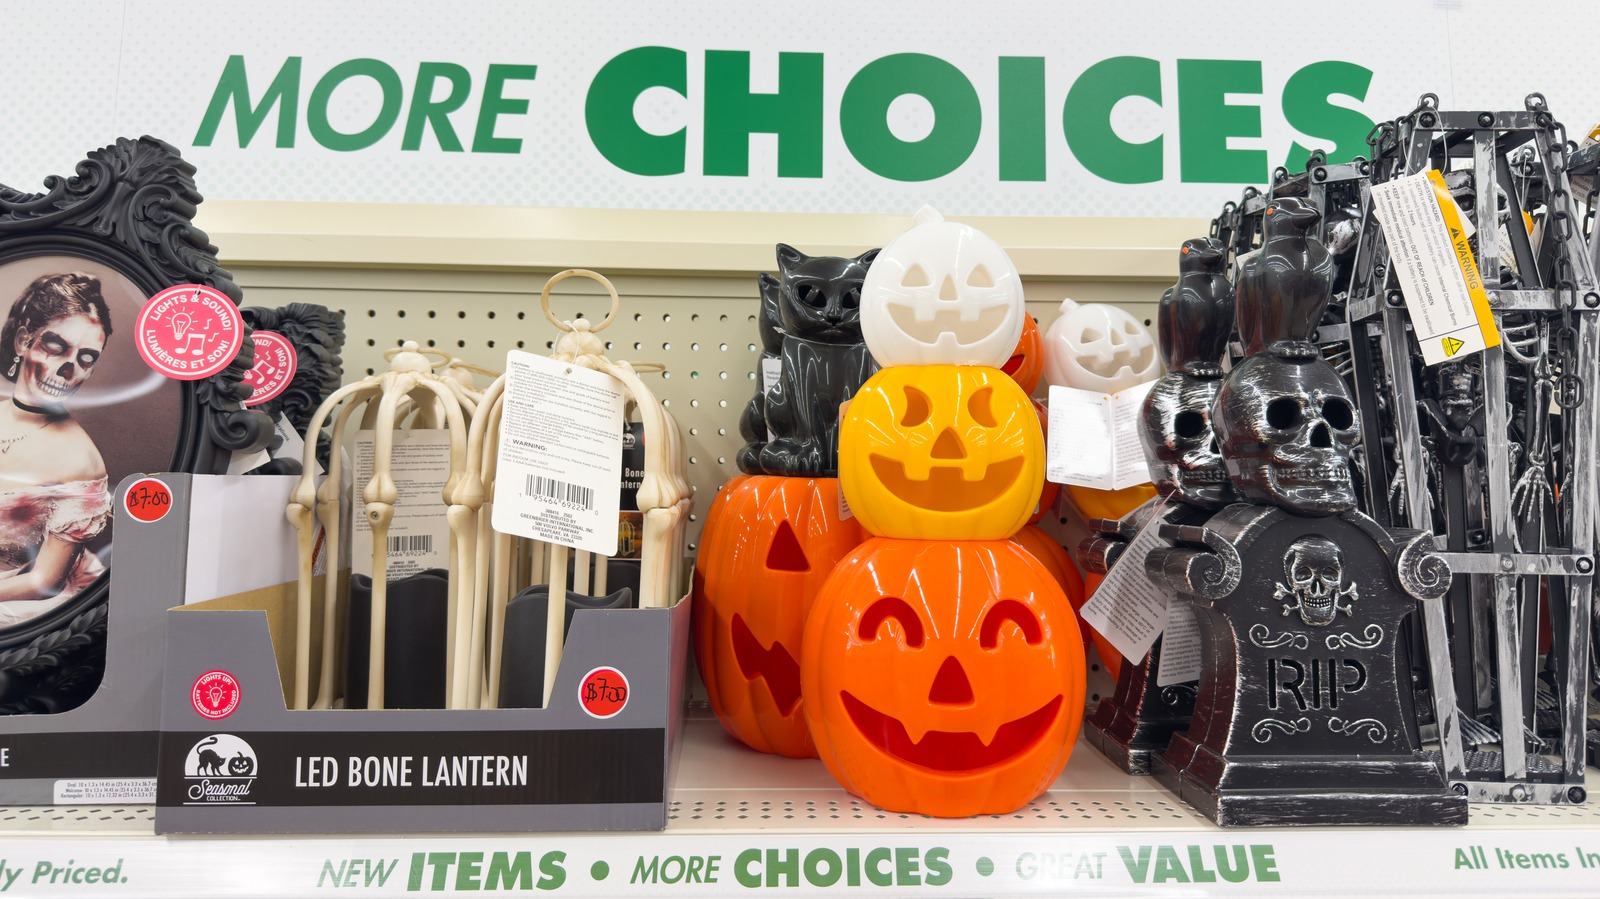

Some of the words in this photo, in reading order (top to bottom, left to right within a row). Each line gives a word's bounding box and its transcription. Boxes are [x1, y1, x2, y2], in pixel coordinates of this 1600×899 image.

[192, 54, 538, 155] MORE
[585, 45, 1380, 184] CHOICES
[1422, 179, 1433, 203] INGESTION
[1387, 201, 1398, 222] immediate
[1394, 222, 1403, 238] medical
[1400, 239, 1409, 258] attention
[1391, 187, 1400, 199] KEEP
[1415, 261, 1425, 277] REACH
[1454, 240, 1479, 290] WARNING
[150, 294, 187, 321] LIGHTS
[190, 294, 199, 303] &
[202, 297, 232, 331] SOUND!
[1438, 276, 1447, 292] Internal
[1443, 292, 1453, 312] Chemical
[1449, 312, 1458, 325] Burns
[146, 329, 187, 369] LUMIÈRES
[191, 359, 205, 369] ET
[207, 339, 230, 364] SON!
[274, 369, 285, 380] ET
[512, 438, 547, 451] WARNING:
[625, 467, 645, 478] Bone
[130, 487, 169, 509] $7.00
[533, 494, 557, 505] 95464
[561, 500, 585, 512] 69224
[520, 512, 548, 523] GREENBRIER
[540, 512, 569, 522] DISTRIBUTED
[539, 531, 553, 539] MADE
[201, 674, 221, 685] LIGHTS
[222, 675, 232, 685] UP!
[585, 677, 627, 703] $7.00
[1267, 658, 1368, 711] RIP
[196, 689, 210, 714] BATTERIES
[222, 690, 236, 714] INCLUDED
[295, 756, 338, 787] LED
[349, 757, 412, 786] BONE
[422, 756, 528, 786] LANTERN
[188, 779, 252, 800] Seasonal
[317, 858, 399, 888] NEW
[407, 850, 567, 892] ITEMS
[630, 855, 721, 884] MORE
[734, 846, 953, 889] CHOICES
[1015, 851, 1107, 881] GREAT
[1115, 844, 1281, 884] VALUE
[1454, 845, 1489, 870] All
[1494, 847, 1570, 869] Items
[31, 858, 128, 884] Priced.
